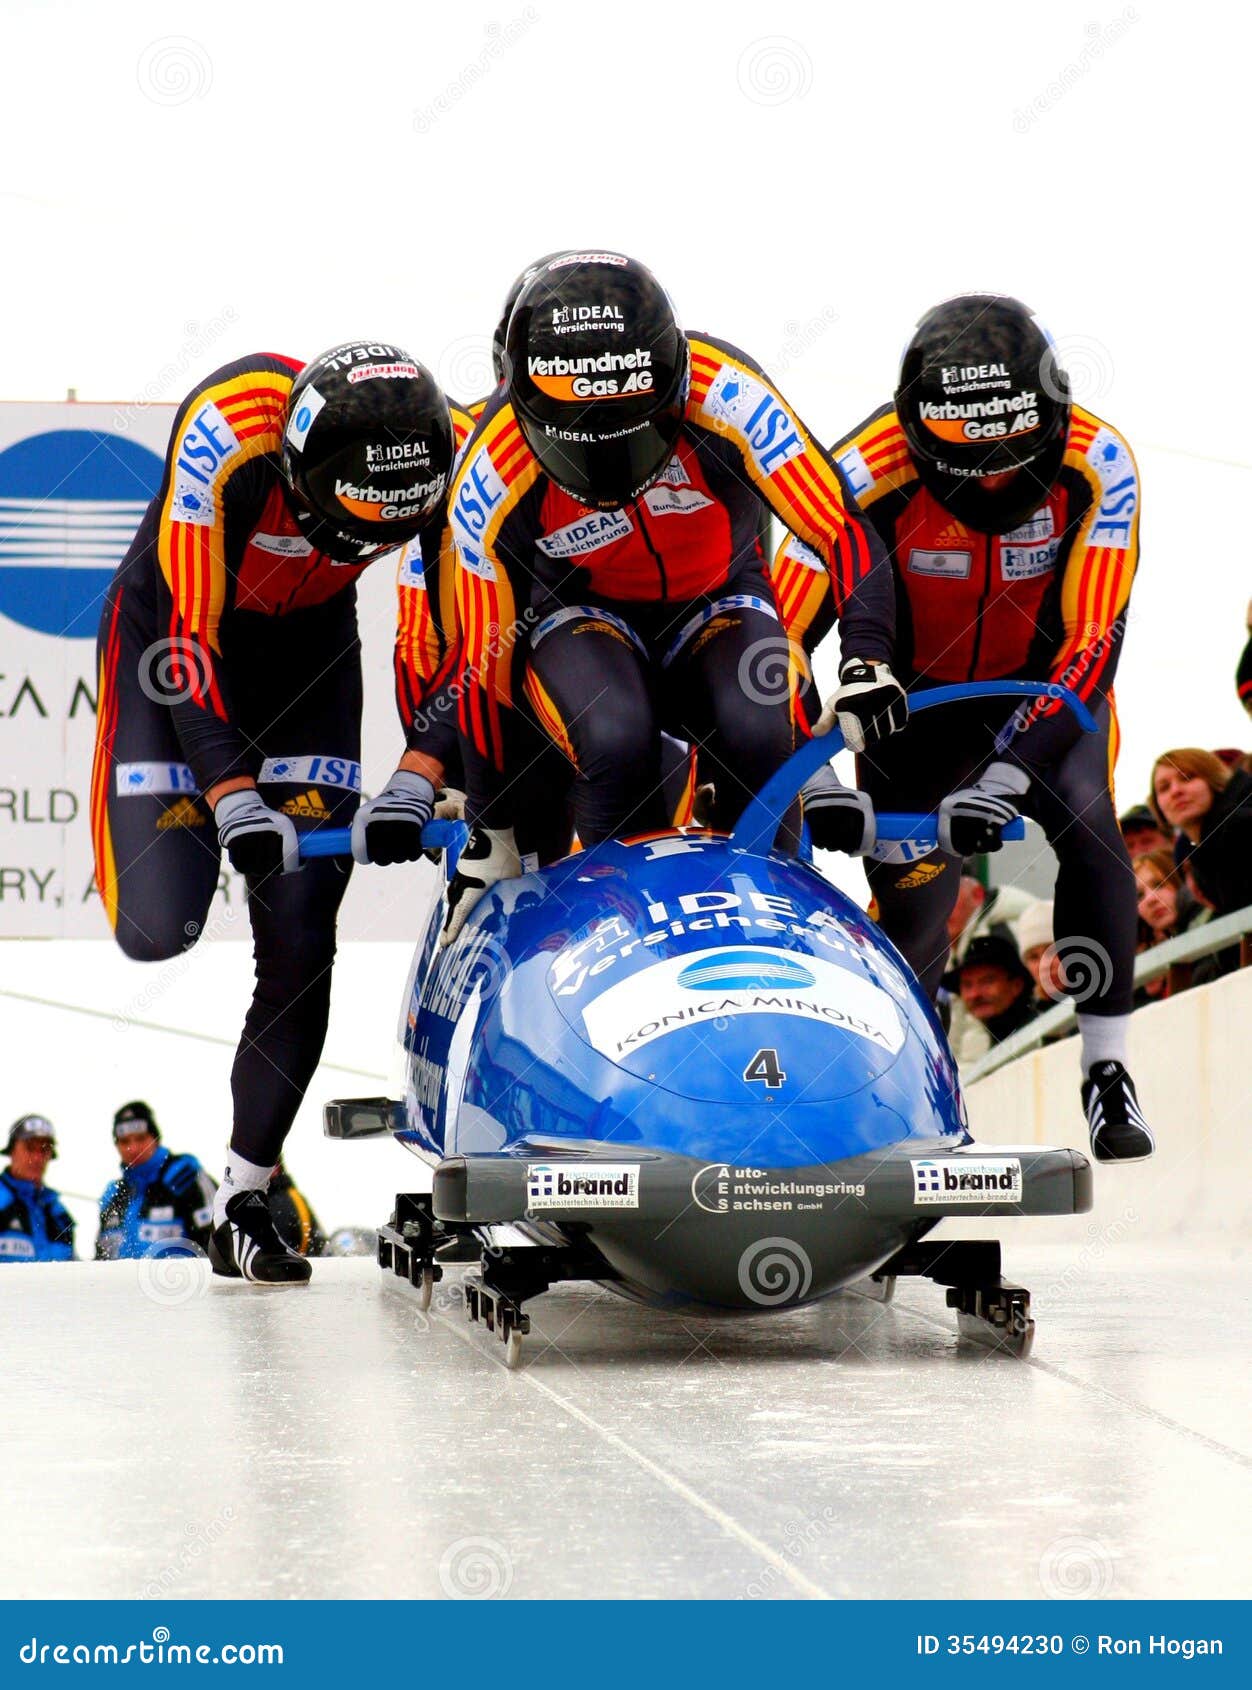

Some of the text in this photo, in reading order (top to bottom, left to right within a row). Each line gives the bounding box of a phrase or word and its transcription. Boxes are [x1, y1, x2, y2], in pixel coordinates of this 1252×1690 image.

[573, 306, 624, 320] IDEAL
[553, 321, 625, 335] Versicherung
[528, 348, 652, 376] Verbundnetz
[961, 364, 1010, 381] IDEAL
[572, 370, 654, 398] Gas AG
[943, 379, 1012, 395] Versicherung
[919, 390, 1038, 420] Verbundnetz
[559, 420, 651, 443] IDEAL Versicherung
[744, 394, 804, 474] ISE
[963, 410, 1040, 440] Gas AG
[177, 408, 233, 485] ISE
[387, 441, 430, 460] IDEAL
[367, 456, 431, 473] Versicherung
[334, 472, 447, 504] Verbundnetz
[454, 454, 503, 543] ISE
[380, 502, 421, 521] Gas
[1090, 476, 1136, 541] ISE
[550, 525, 630, 556] Versicherung
[566, 511, 624, 543] IDEAL
[616, 996, 894, 1053] KONICA MINOLTA
[743, 1048, 787, 1089] 4
[558, 1173, 629, 1196] brand
[943, 1168, 1012, 1191] brand
[797, 1202, 823, 1210] GmbH
